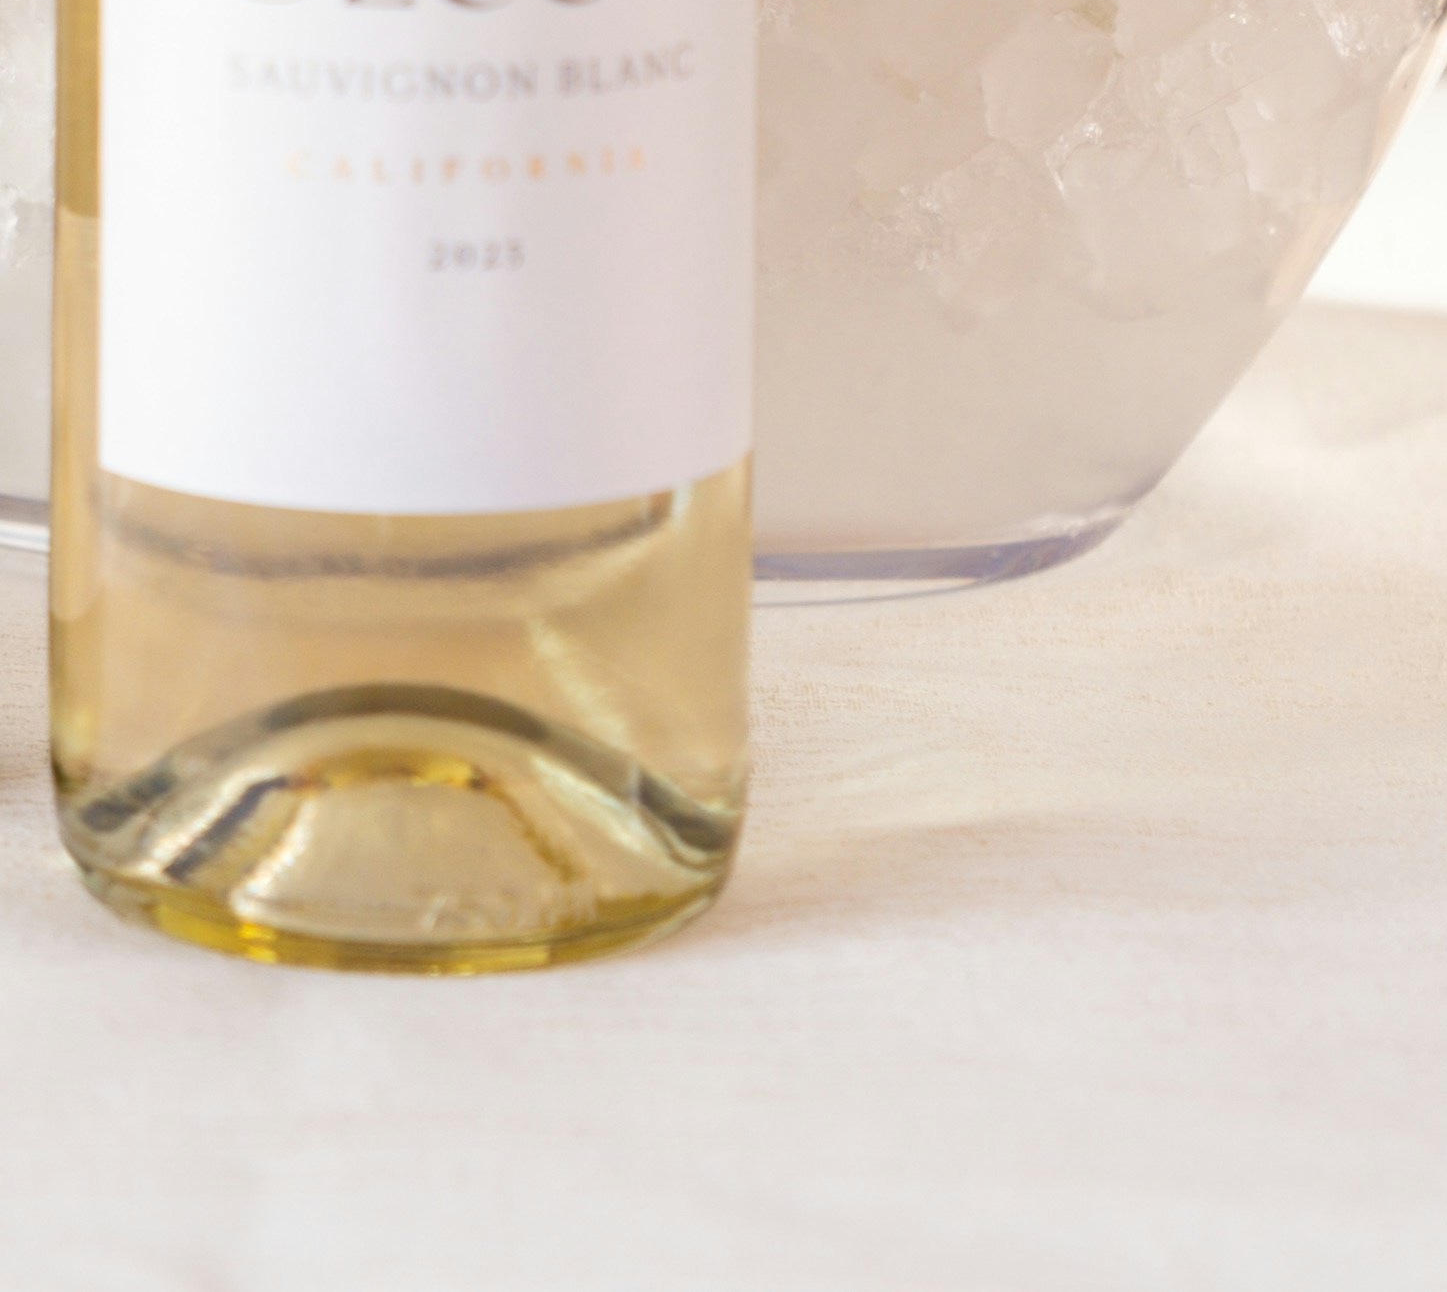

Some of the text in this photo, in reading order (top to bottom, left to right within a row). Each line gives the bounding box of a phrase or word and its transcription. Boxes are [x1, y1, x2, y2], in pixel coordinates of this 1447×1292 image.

[226, 38, 697, 105] SAUVIGNON BLANC
[283, 144, 649, 187] CALIFORNIA
